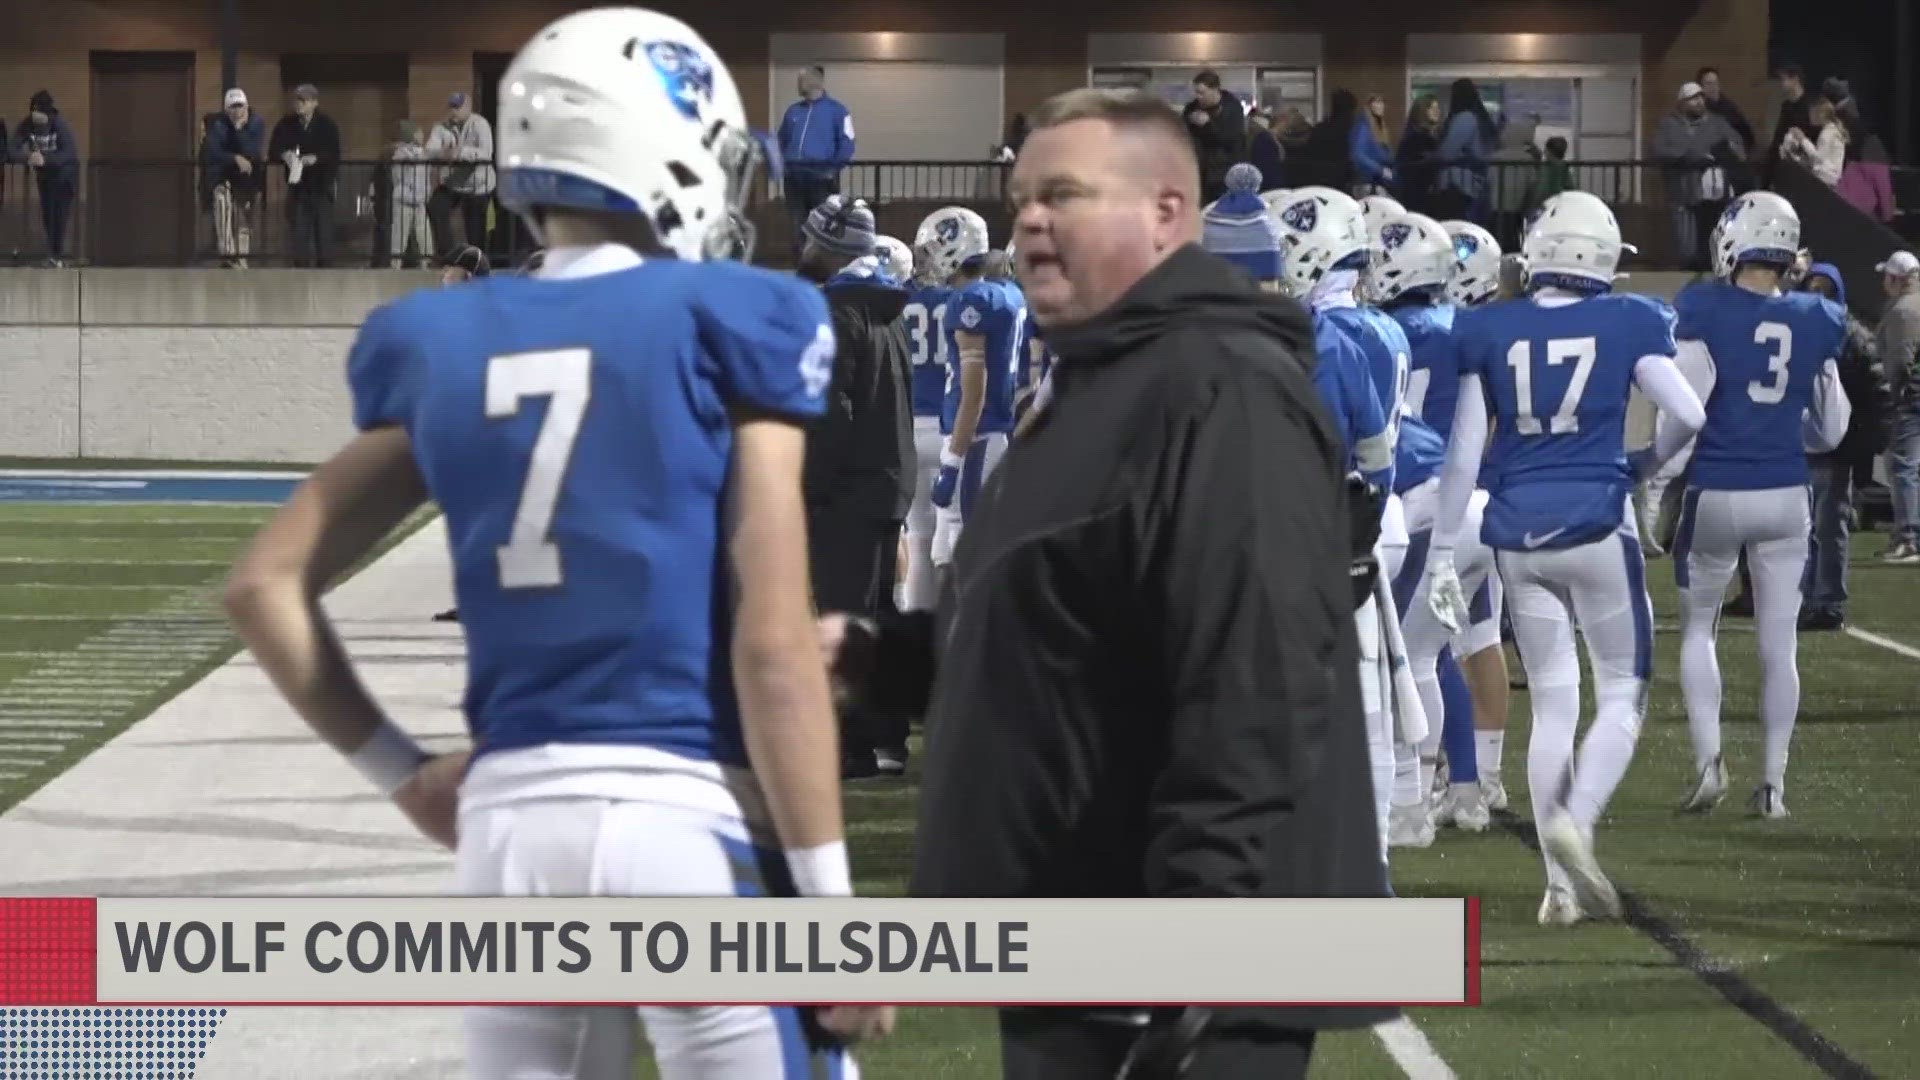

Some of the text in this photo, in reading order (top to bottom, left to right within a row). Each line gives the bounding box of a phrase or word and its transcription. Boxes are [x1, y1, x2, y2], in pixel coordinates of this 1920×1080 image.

[902, 302, 948, 366] 31
[1747, 321, 1793, 404] 3
[1506, 336, 1597, 435] 17
[484, 346, 593, 588] 7
